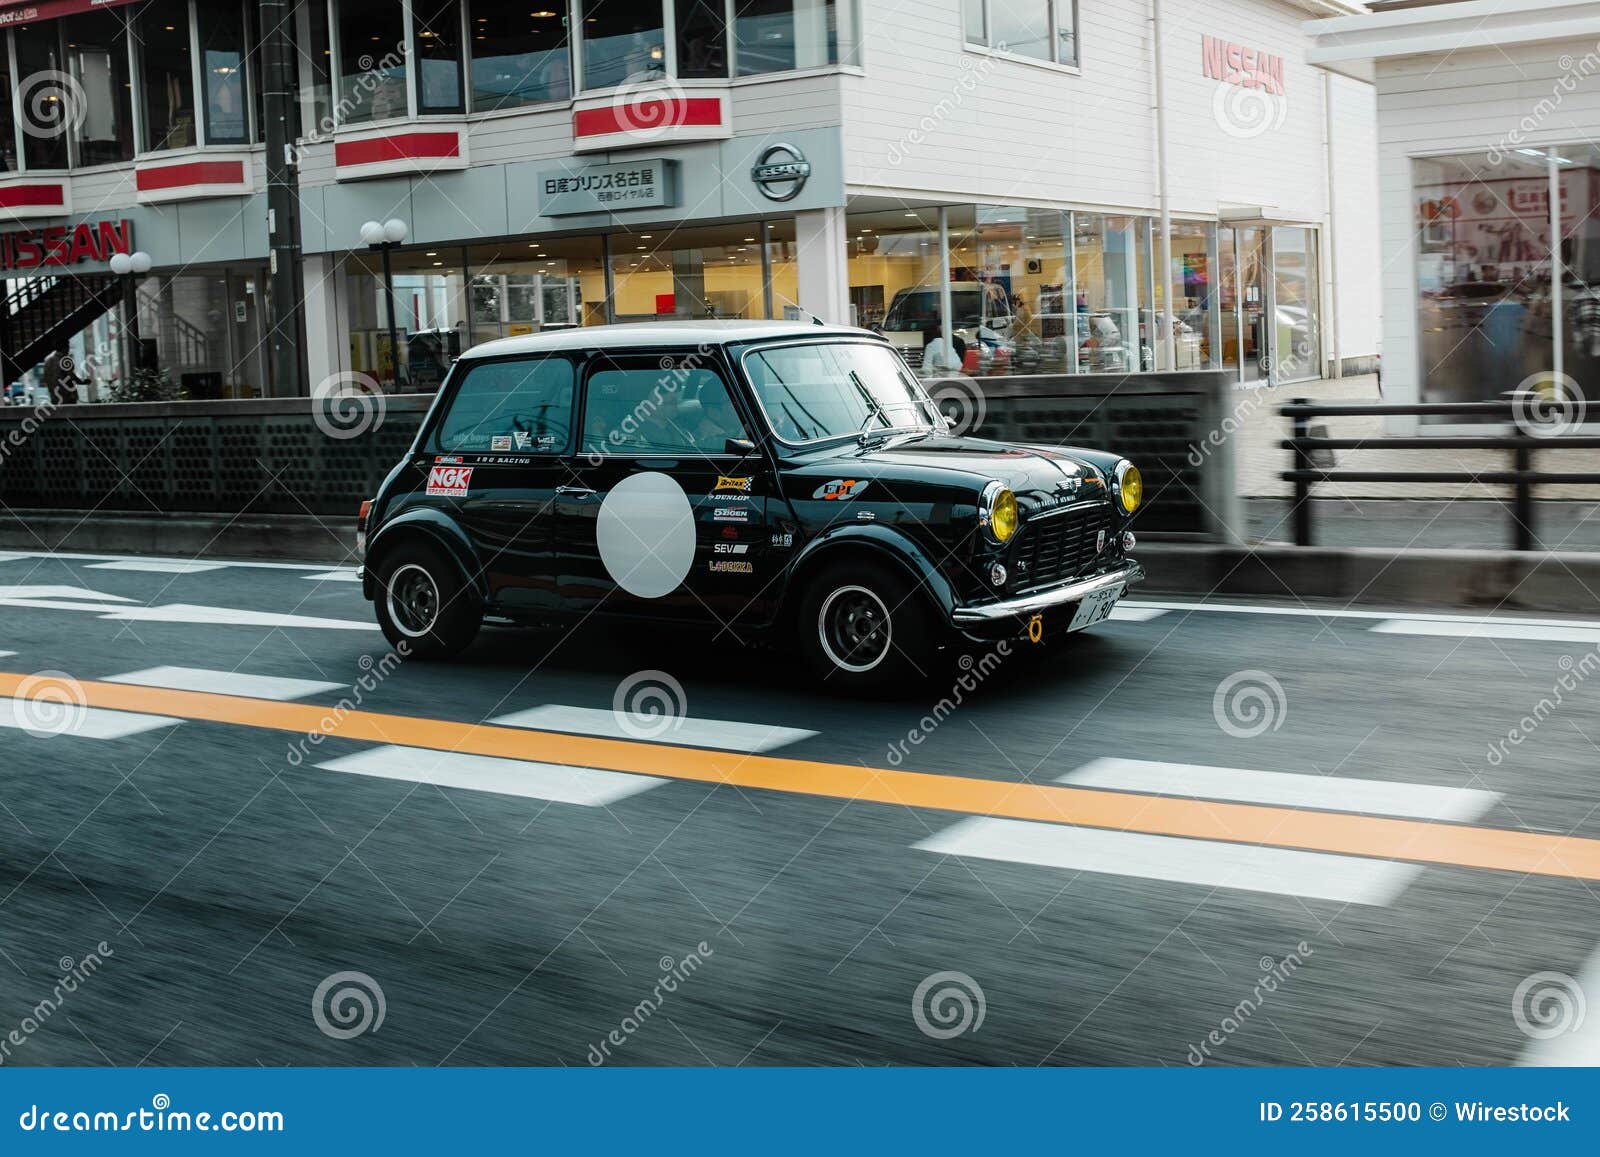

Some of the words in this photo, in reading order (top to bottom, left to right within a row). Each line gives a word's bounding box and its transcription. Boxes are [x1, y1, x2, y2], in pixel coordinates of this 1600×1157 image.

[1201, 34, 1285, 96] NISSAN
[545, 168, 654, 194] 日産プリンス名古屋
[0, 219, 130, 270] ISSAN
[429, 469, 471, 488] NGK
[714, 544, 734, 553] SEV
